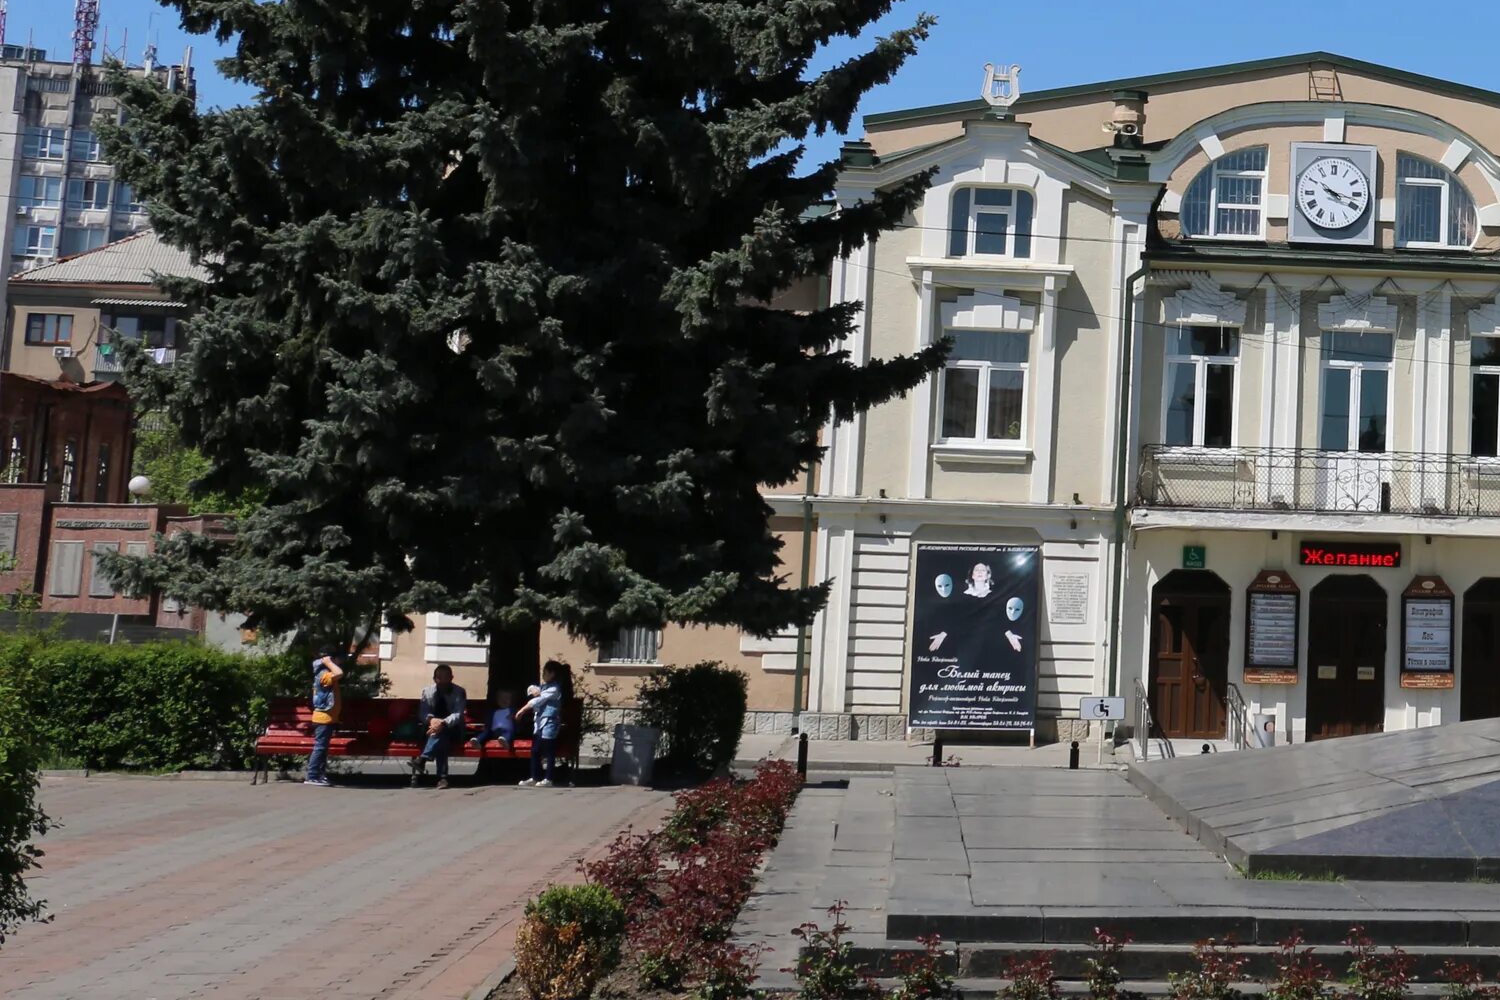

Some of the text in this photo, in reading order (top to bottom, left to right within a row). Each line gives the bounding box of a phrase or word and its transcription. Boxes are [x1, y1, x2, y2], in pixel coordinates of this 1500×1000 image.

[937, 665, 1011, 680] Белый танец
[919, 680, 1026, 695] для любимой актрисы
